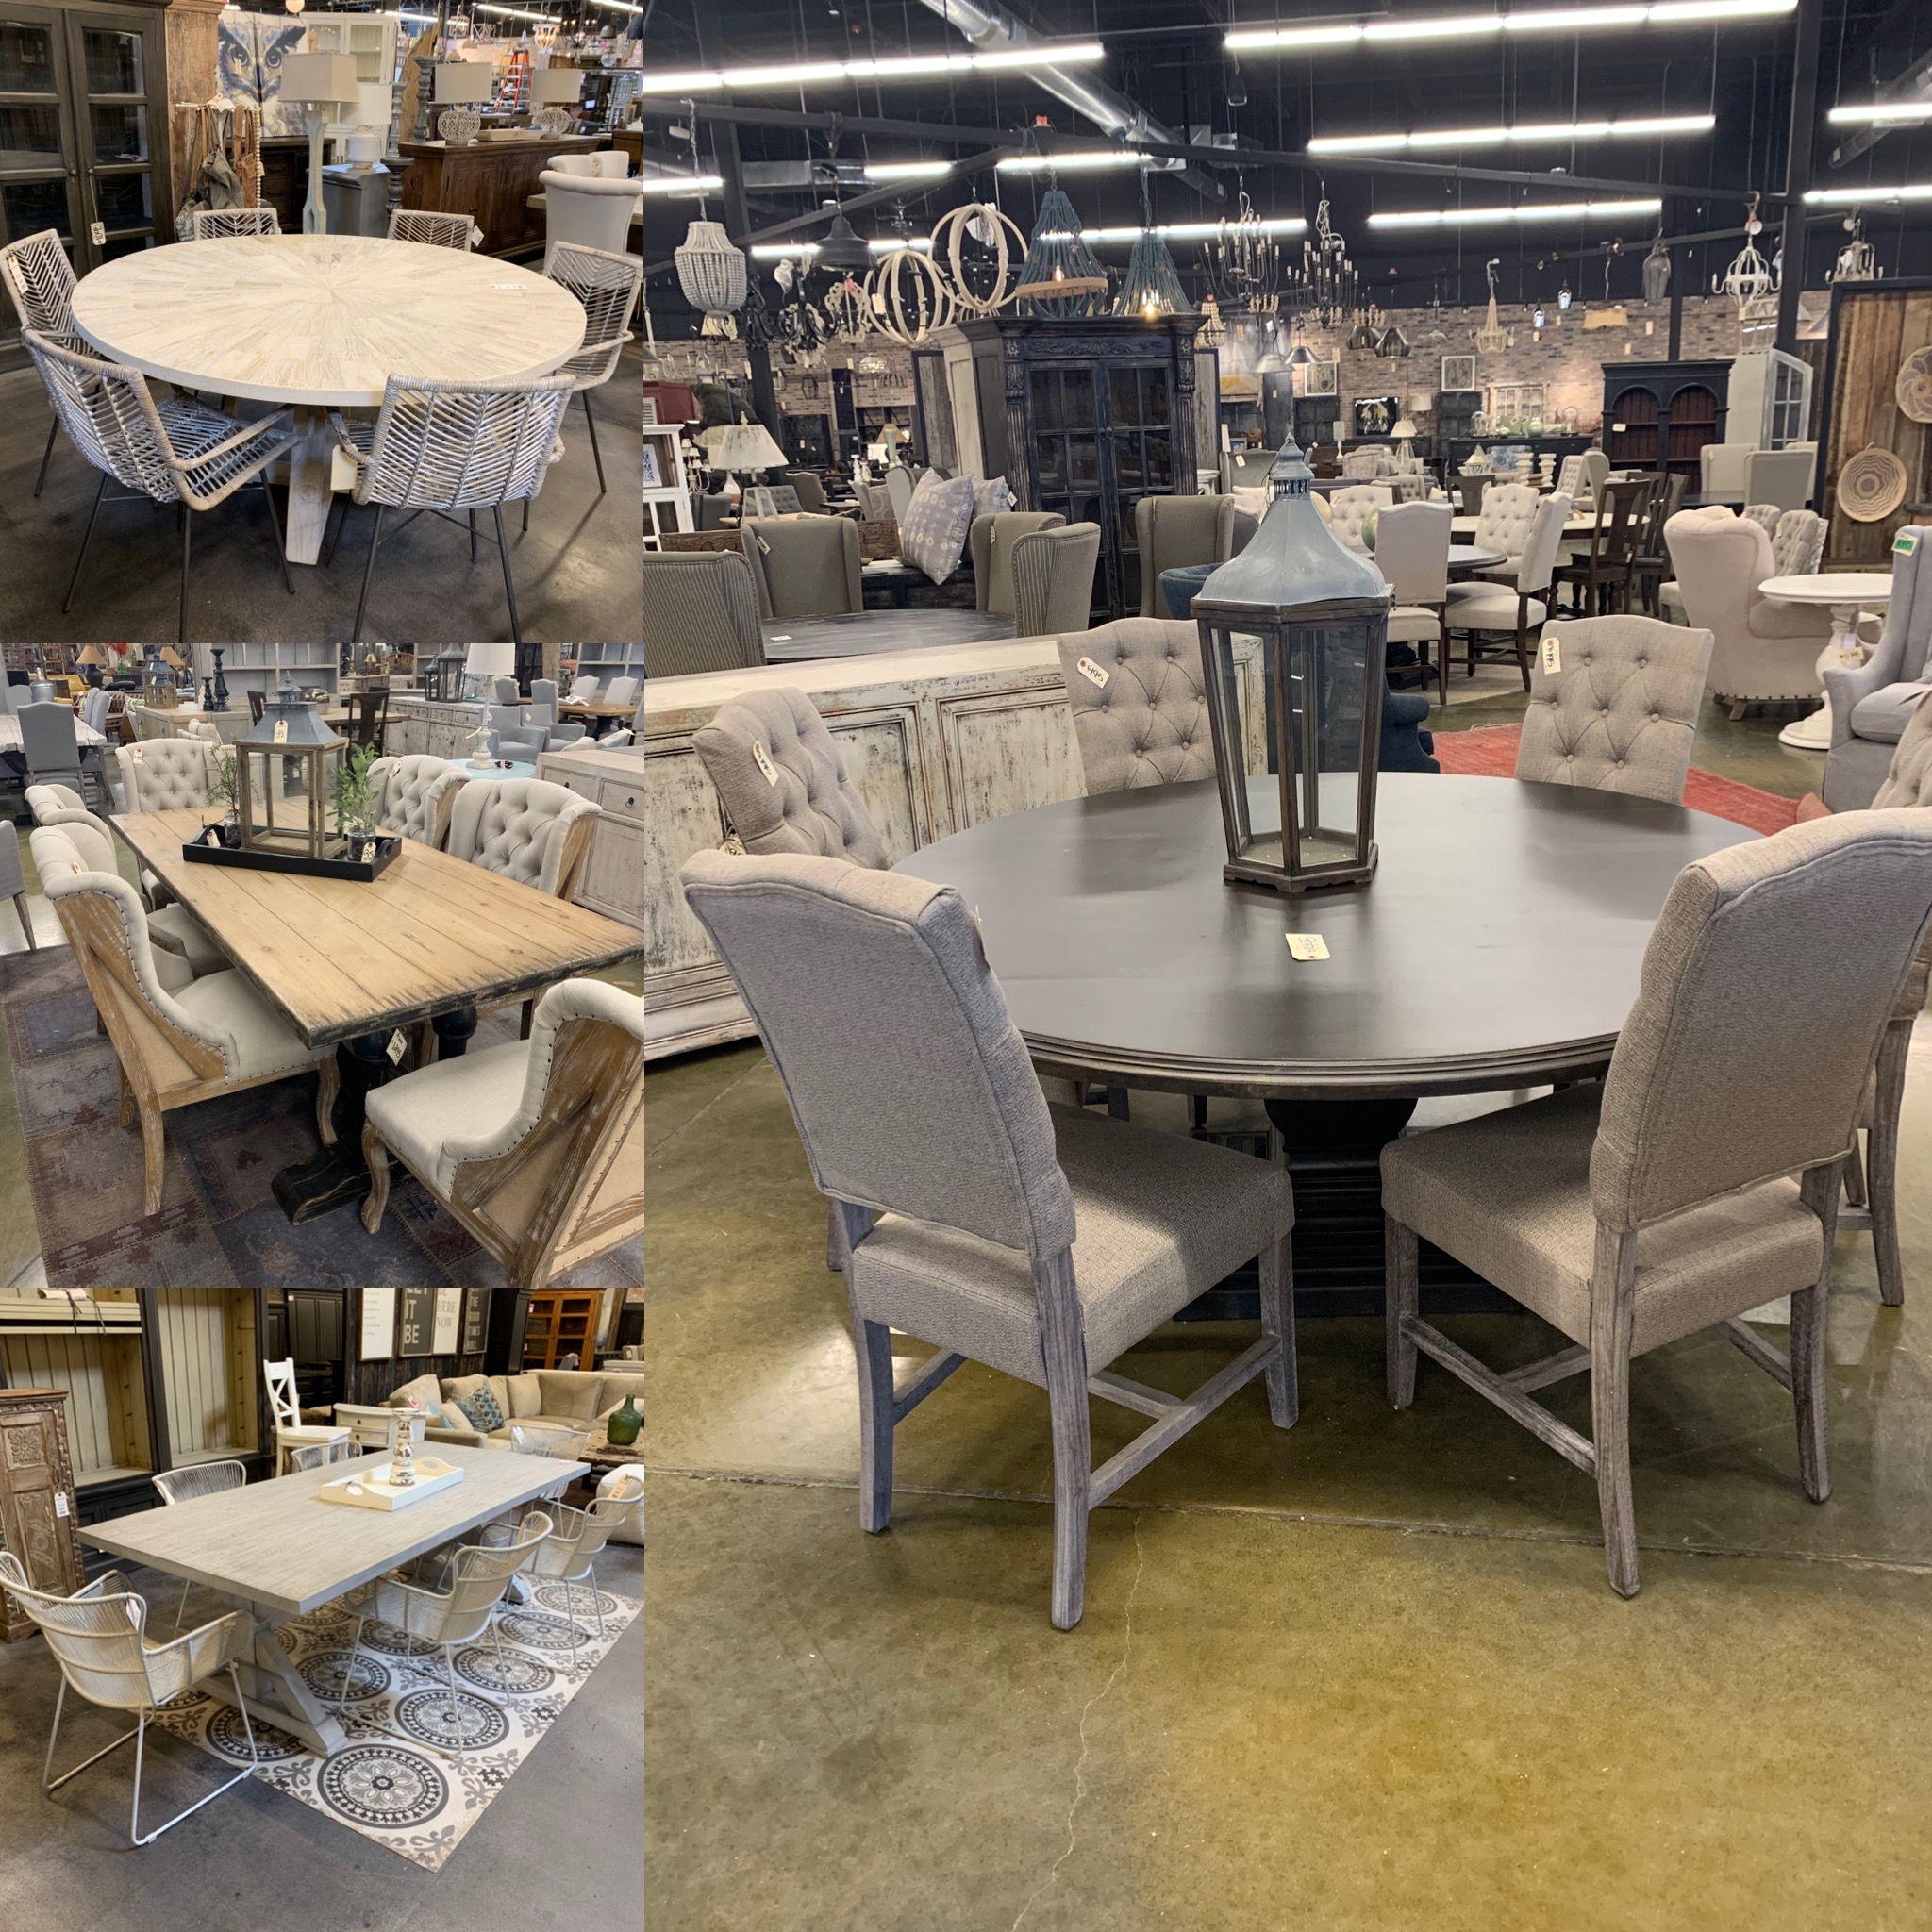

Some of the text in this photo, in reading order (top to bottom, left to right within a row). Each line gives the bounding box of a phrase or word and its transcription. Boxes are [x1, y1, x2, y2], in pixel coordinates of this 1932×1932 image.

[405, 1299, 417, 1320] IT
[437, 1300, 457, 1313] HERE
[436, 1317, 454, 1328] NOW
[404, 1324, 420, 1344] BE
